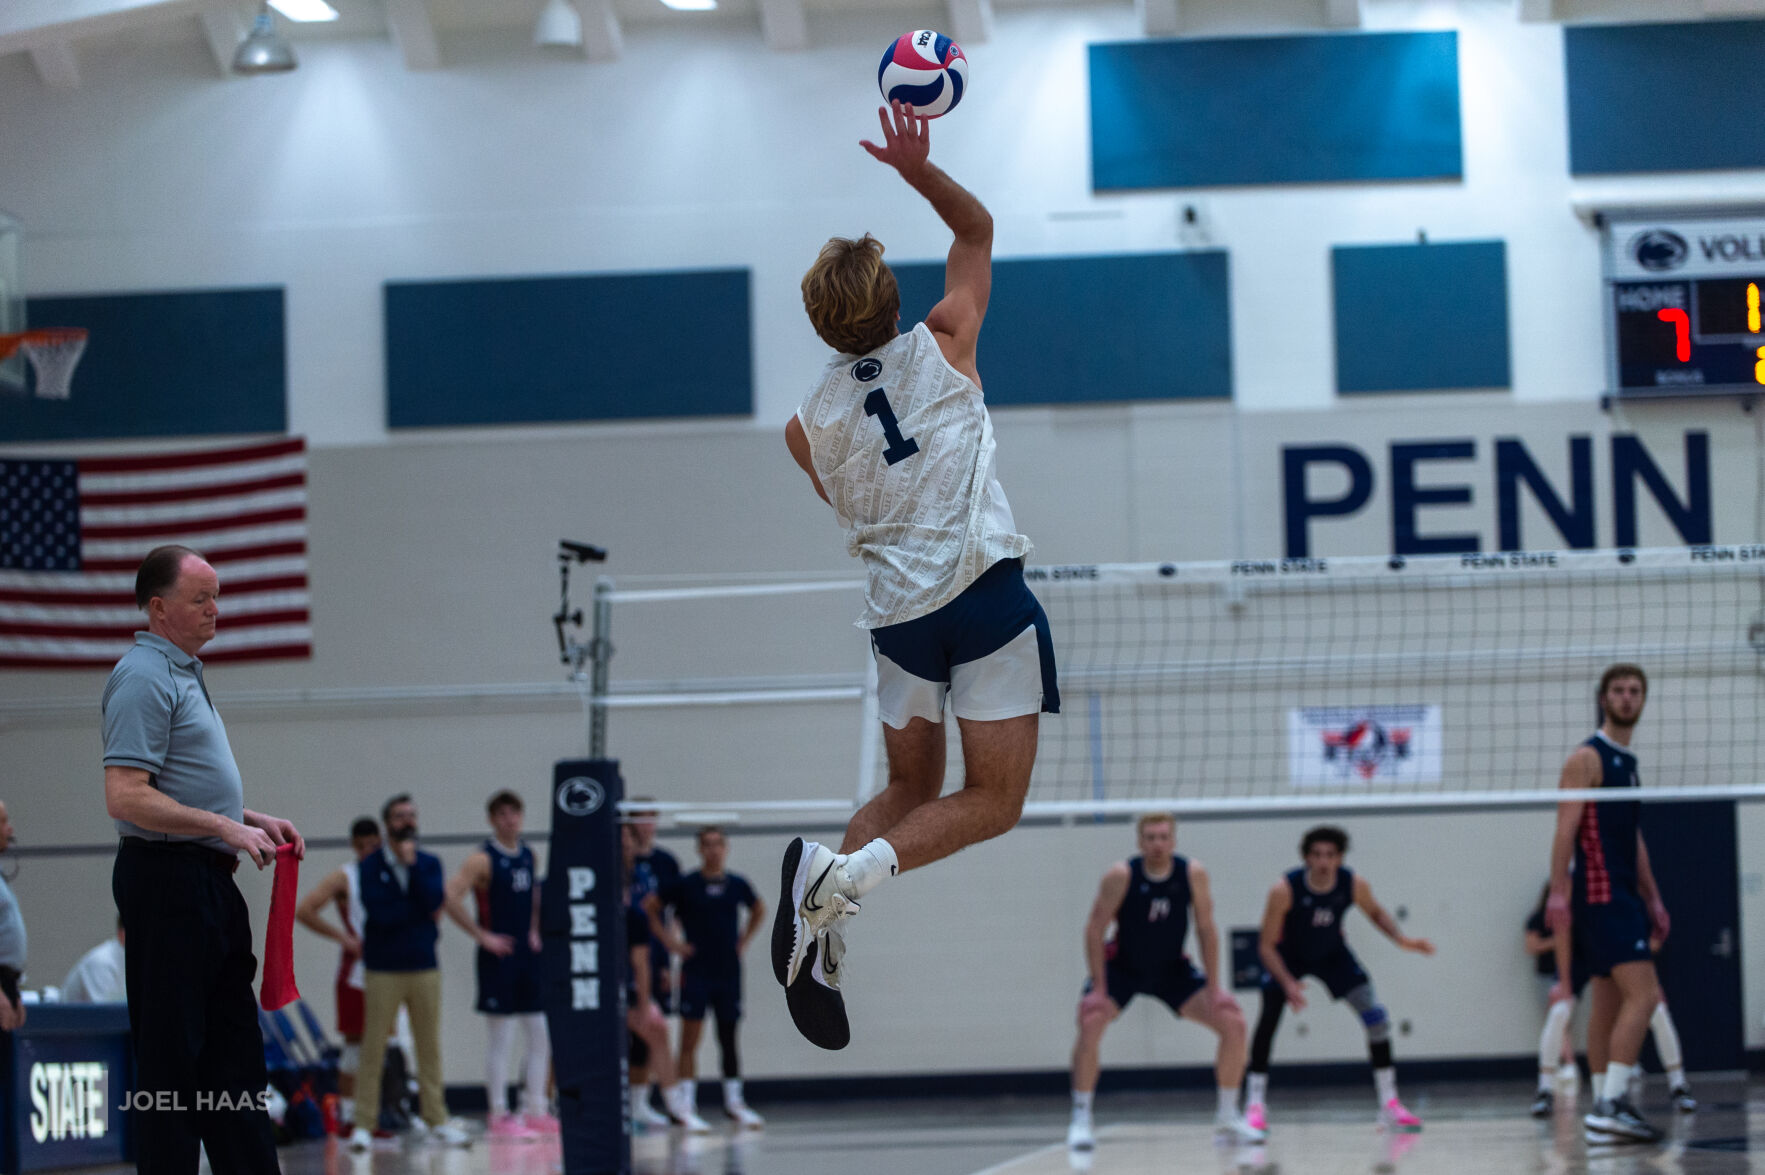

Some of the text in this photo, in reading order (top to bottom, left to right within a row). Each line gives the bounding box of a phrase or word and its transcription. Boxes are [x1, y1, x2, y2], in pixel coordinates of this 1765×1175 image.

[1657, 308, 1691, 362] 7
[864, 387, 919, 466] 1
[1281, 429, 1713, 558] PENN
[1051, 567, 1098, 581] STATE
[1231, 559, 1328, 576] PENN STATE
[1461, 552, 1558, 568] PENN STATE
[1691, 547, 1735, 562] PENN
[567, 866, 600, 1011] PENN
[29, 1061, 106, 1143] STATE
